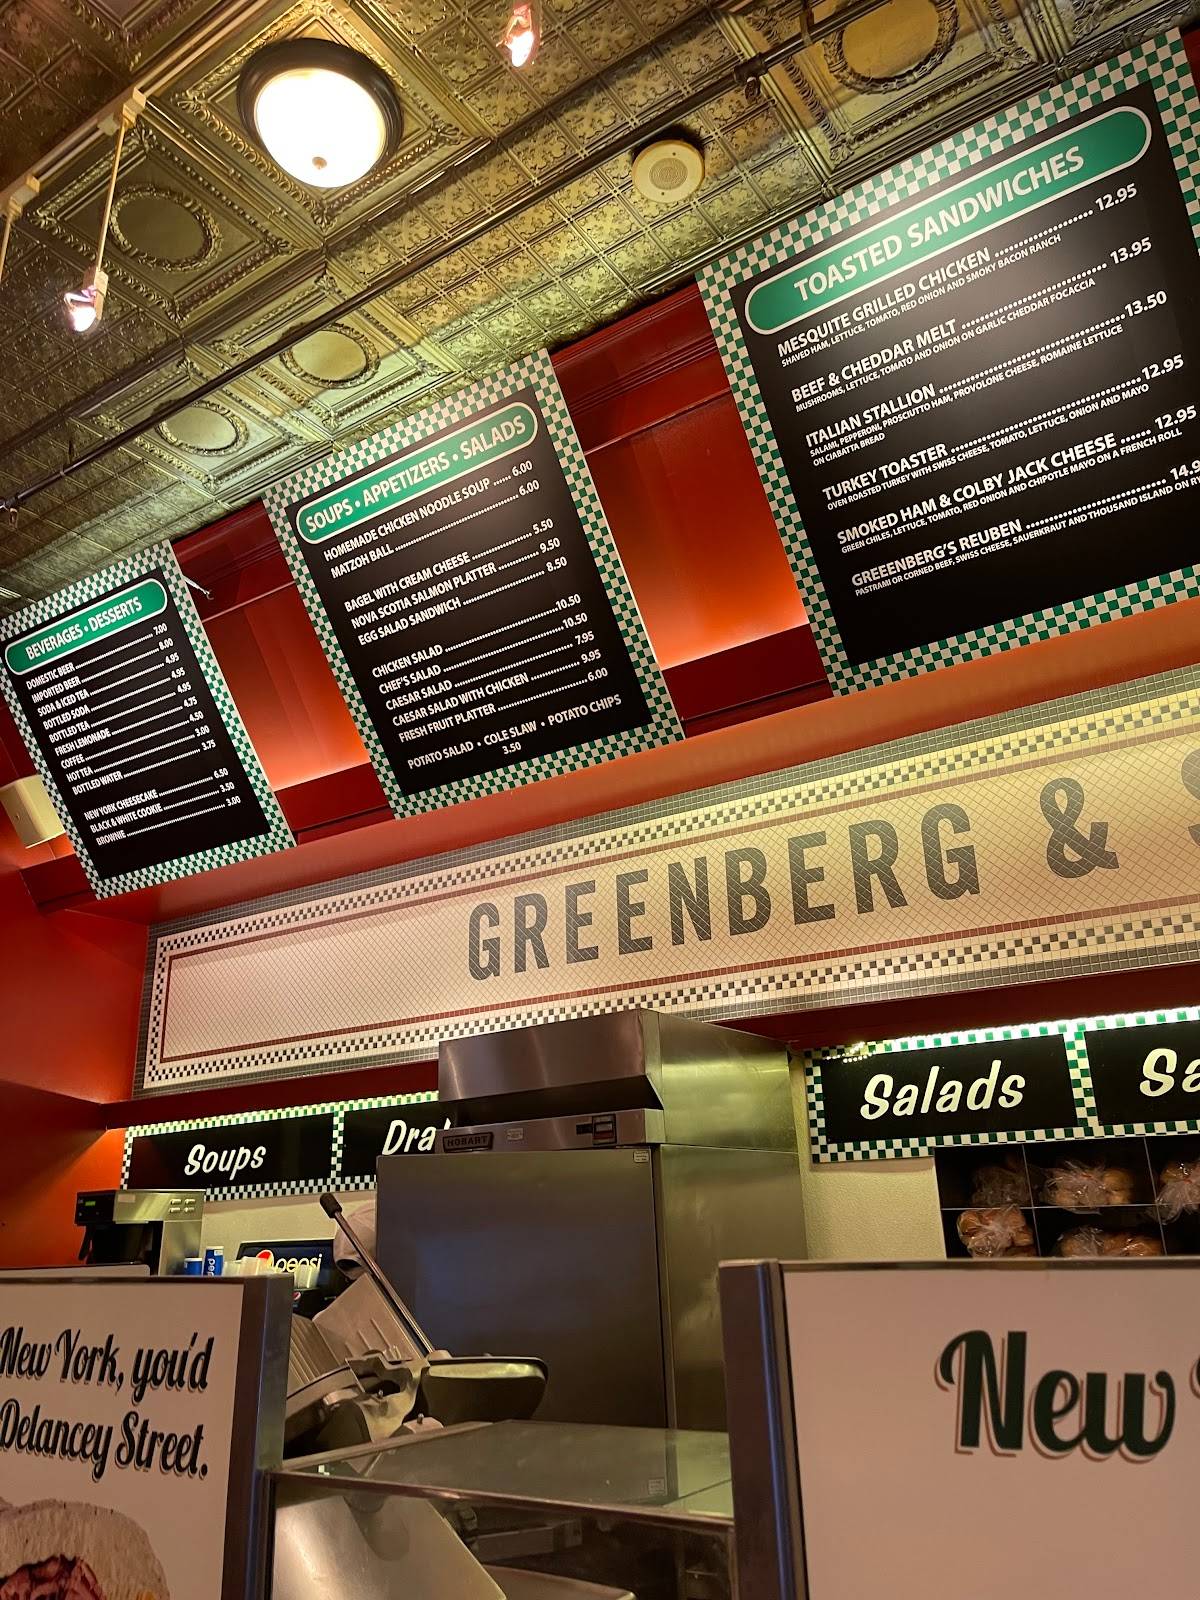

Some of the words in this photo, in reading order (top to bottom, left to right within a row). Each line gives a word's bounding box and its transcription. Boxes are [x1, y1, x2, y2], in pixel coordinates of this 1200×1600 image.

[794, 234, 903, 302] TOASTED
[906, 145, 1085, 248] SANDWICHES
[777, 311, 851, 357] MESQUITE
[852, 282, 915, 321] GRILLED
[918, 246, 992, 290] CHICKEN
[1095, 182, 1137, 210] 12.95
[781, 348, 810, 367] SHAVED
[810, 339, 830, 354] HAM,
[830, 323, 865, 344] LETTUCE,
[864, 308, 900, 328] TOMATO,
[900, 299, 917, 312] RED
[917, 285, 945, 304] ONION
[946, 277, 965, 292] AND
[965, 262, 996, 282] SMOKY
[997, 248, 1028, 268] BACON
[1028, 233, 1061, 254] RANCH
[791, 376, 825, 402] BEEF
[828, 372, 840, 386] &
[841, 338, 915, 380] CHEDDAR
[915, 318, 955, 348] MELT
[1110, 236, 1151, 264] 13.95
[795, 385, 845, 412] MUSHROOMS,
[845, 370, 880, 391] LETTUCE,
[879, 356, 913, 375] TOMATO
[914, 348, 932, 361] AND
[932, 335, 960, 353] ONION
[960, 329, 975, 341] ON
[975, 315, 1006, 334] GARLIC
[1006, 297, 1050, 321] CHEDDAR
[1049, 277, 1095, 303] FOCACCIA
[805, 413, 861, 447] ITALIAN
[862, 382, 935, 424] STALLION
[1124, 290, 1166, 316] 13.50
[822, 468, 876, 500] TURKEY
[878, 443, 948, 478] TOASTER
[1141, 354, 1183, 379] 12.95
[305, 500, 354, 534] SOUPS
[361, 452, 450, 506] APPETIZERS
[459, 414, 527, 457] SALADS
[323, 528, 378, 561] HOMEMADE
[377, 509, 420, 536] CHICKEN
[418, 490, 462, 518] NOODLE
[461, 477, 489, 499] SOUP
[511, 460, 532, 476] 6.00
[837, 512, 898, 544] SMOKED
[899, 497, 937, 521] HAM
[939, 493, 952, 507] &
[952, 472, 1002, 502] COLBY
[1007, 456, 1049, 484] JACK
[1050, 432, 1117, 467] CHEESE
[1154, 405, 1196, 429] 12.95
[330, 553, 370, 578] MATZOH
[368, 543, 394, 561] BALL
[518, 479, 539, 495] 6.00
[344, 592, 375, 612] BAGEL
[372, 581, 399, 599] WITH
[398, 567, 433, 589] CREAM
[432, 551, 470, 575] CHEESE
[532, 518, 553, 534] 5.50
[855, 578, 891, 596] PASTRAMI
[891, 575, 903, 584] OR
[903, 564, 934, 580] CORNED
[934, 557, 955, 570] BEEF,
[955, 549, 979, 563] SWISS
[979, 539, 1012, 554] CHEESE,
[1012, 519, 1066, 544] SAUERKRAUT
[1068, 513, 1087, 526] AND
[1087, 496, 1138, 519] THOUSAND
[1138, 485, 1173, 502] ISLAND
[1174, 479, 1189, 490] ON
[958, 518, 1022, 550] REUBEN
[350, 610, 379, 629] NOVA
[377, 596, 412, 618] SCOTIA
[410, 579, 453, 605] SALMON
[452, 561, 497, 588] PLATTER
[539, 537, 560, 553] 9.50
[357, 629, 378, 645] EGG
[377, 617, 409, 638] SALAD
[408, 596, 461, 625] SANDWICH
[545, 556, 567, 571] 8.50
[25, 623, 84, 661] BEVERAGES
[88, 596, 143, 633] DESSERTS
[25, 668, 59, 689] DOMESTIC
[56, 662, 75, 676] BEER
[152, 622, 167, 635] 7.00
[31, 682, 64, 703] IMPORTED
[62, 675, 81, 690] BEER
[158, 637, 173, 650] 8.00
[372, 655, 412, 677] CHICKEN
[410, 644, 443, 664] SALAD
[555, 593, 581, 610] 10.50
[378, 675, 410, 694] CHEF'S
[409, 664, 441, 683] SALAD
[562, 612, 587, 628] 10.50
[385, 690, 421, 710] CAESAR
[420, 679, 452, 698] SALAD
[574, 630, 594, 644] 7.95
[37, 702, 56, 716] SODA
[54, 699, 62, 709] &
[59, 693, 76, 707] ICED
[74, 688, 89, 701] TEA
[165, 652, 179, 664] 4.95
[54, 741, 75, 756] FRESH
[73, 727, 111, 749] LEMONADE
[183, 695, 197, 707] 4.75
[392, 707, 428, 726] CAESAR
[427, 696, 458, 714] SALAD
[457, 687, 485, 704] WITH
[485, 671, 529, 695] CHICKEN
[580, 648, 601, 663] 9.95
[398, 725, 428, 742] FRESH
[426, 716, 454, 733] FRUIT
[454, 703, 496, 724] PLATTER
[587, 667, 608, 681] 6.00
[60, 753, 85, 769] COFFEE
[189, 710, 203, 721] 4.50
[71, 778, 101, 795] BOTTLED
[98, 770, 123, 785] WATER
[201, 738, 216, 750] 3.75
[407, 750, 442, 769] POTATO
[442, 741, 473, 758] SALAD
[483, 729, 509, 745] COLE
[508, 720, 536, 737] SLAW
[547, 704, 588, 725] POTATO
[589, 693, 621, 712] CHIPS
[501, 741, 521, 754] 3.50
[83, 808, 99, 820] NEW
[97, 802, 117, 815] YORK
[115, 788, 158, 809] CHEESECAKE
[213, 767, 228, 778] 6.50
[95, 829, 126, 845] BROWNIE
[225, 795, 241, 806] 3.00
[467, 803, 981, 981] GREENBERG
[1039, 777, 1120, 879] &
[860, 1059, 1026, 1120] Salads
[184, 1143, 267, 1181] Soups
[55, 1328, 125, 1396] York,
[131, 1331, 215, 1404] you'd
[935, 1329, 1176, 1465] New
[0, 1397, 114, 1481] Delancey
[115, 1410, 209, 1479] Street.
